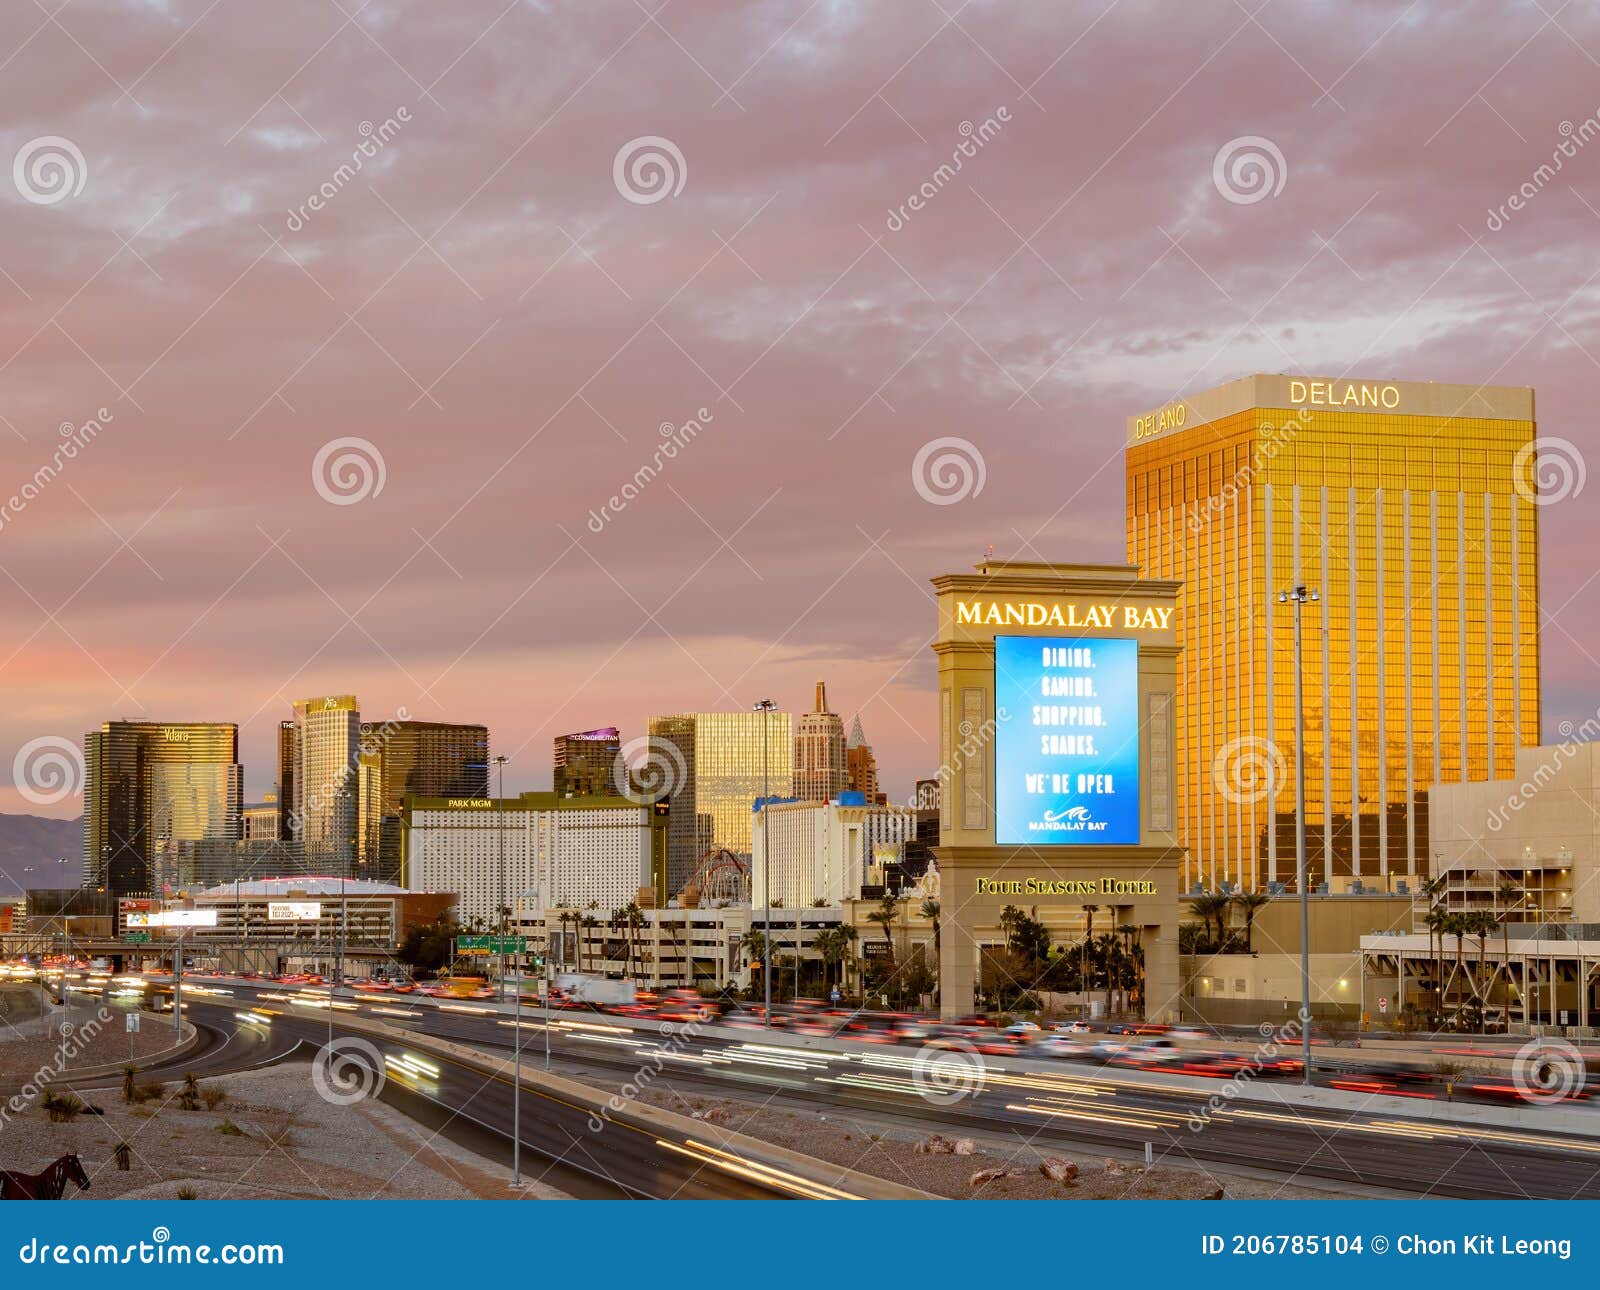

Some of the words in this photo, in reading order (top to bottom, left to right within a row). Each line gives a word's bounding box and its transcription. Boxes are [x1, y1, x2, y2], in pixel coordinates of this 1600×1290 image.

[1290, 381, 1400, 409] DELANO
[1136, 404, 1187, 439] DELANO
[957, 601, 1118, 628] MANDALAY
[1124, 606, 1175, 629] BAY
[1032, 705, 1107, 726] SHOPPING.
[165, 727, 189, 742] Vdara
[1025, 773, 1070, 794] WE'RE
[448, 799, 469, 808] PARK
[470, 799, 491, 808] MGM
[1029, 821, 1086, 831] MANDALAY
[1087, 821, 1106, 831] BAY
[975, 877, 1022, 895] FOUR
[1025, 877, 1097, 895] SEASONS
[1100, 877, 1157, 895] HOTEL
